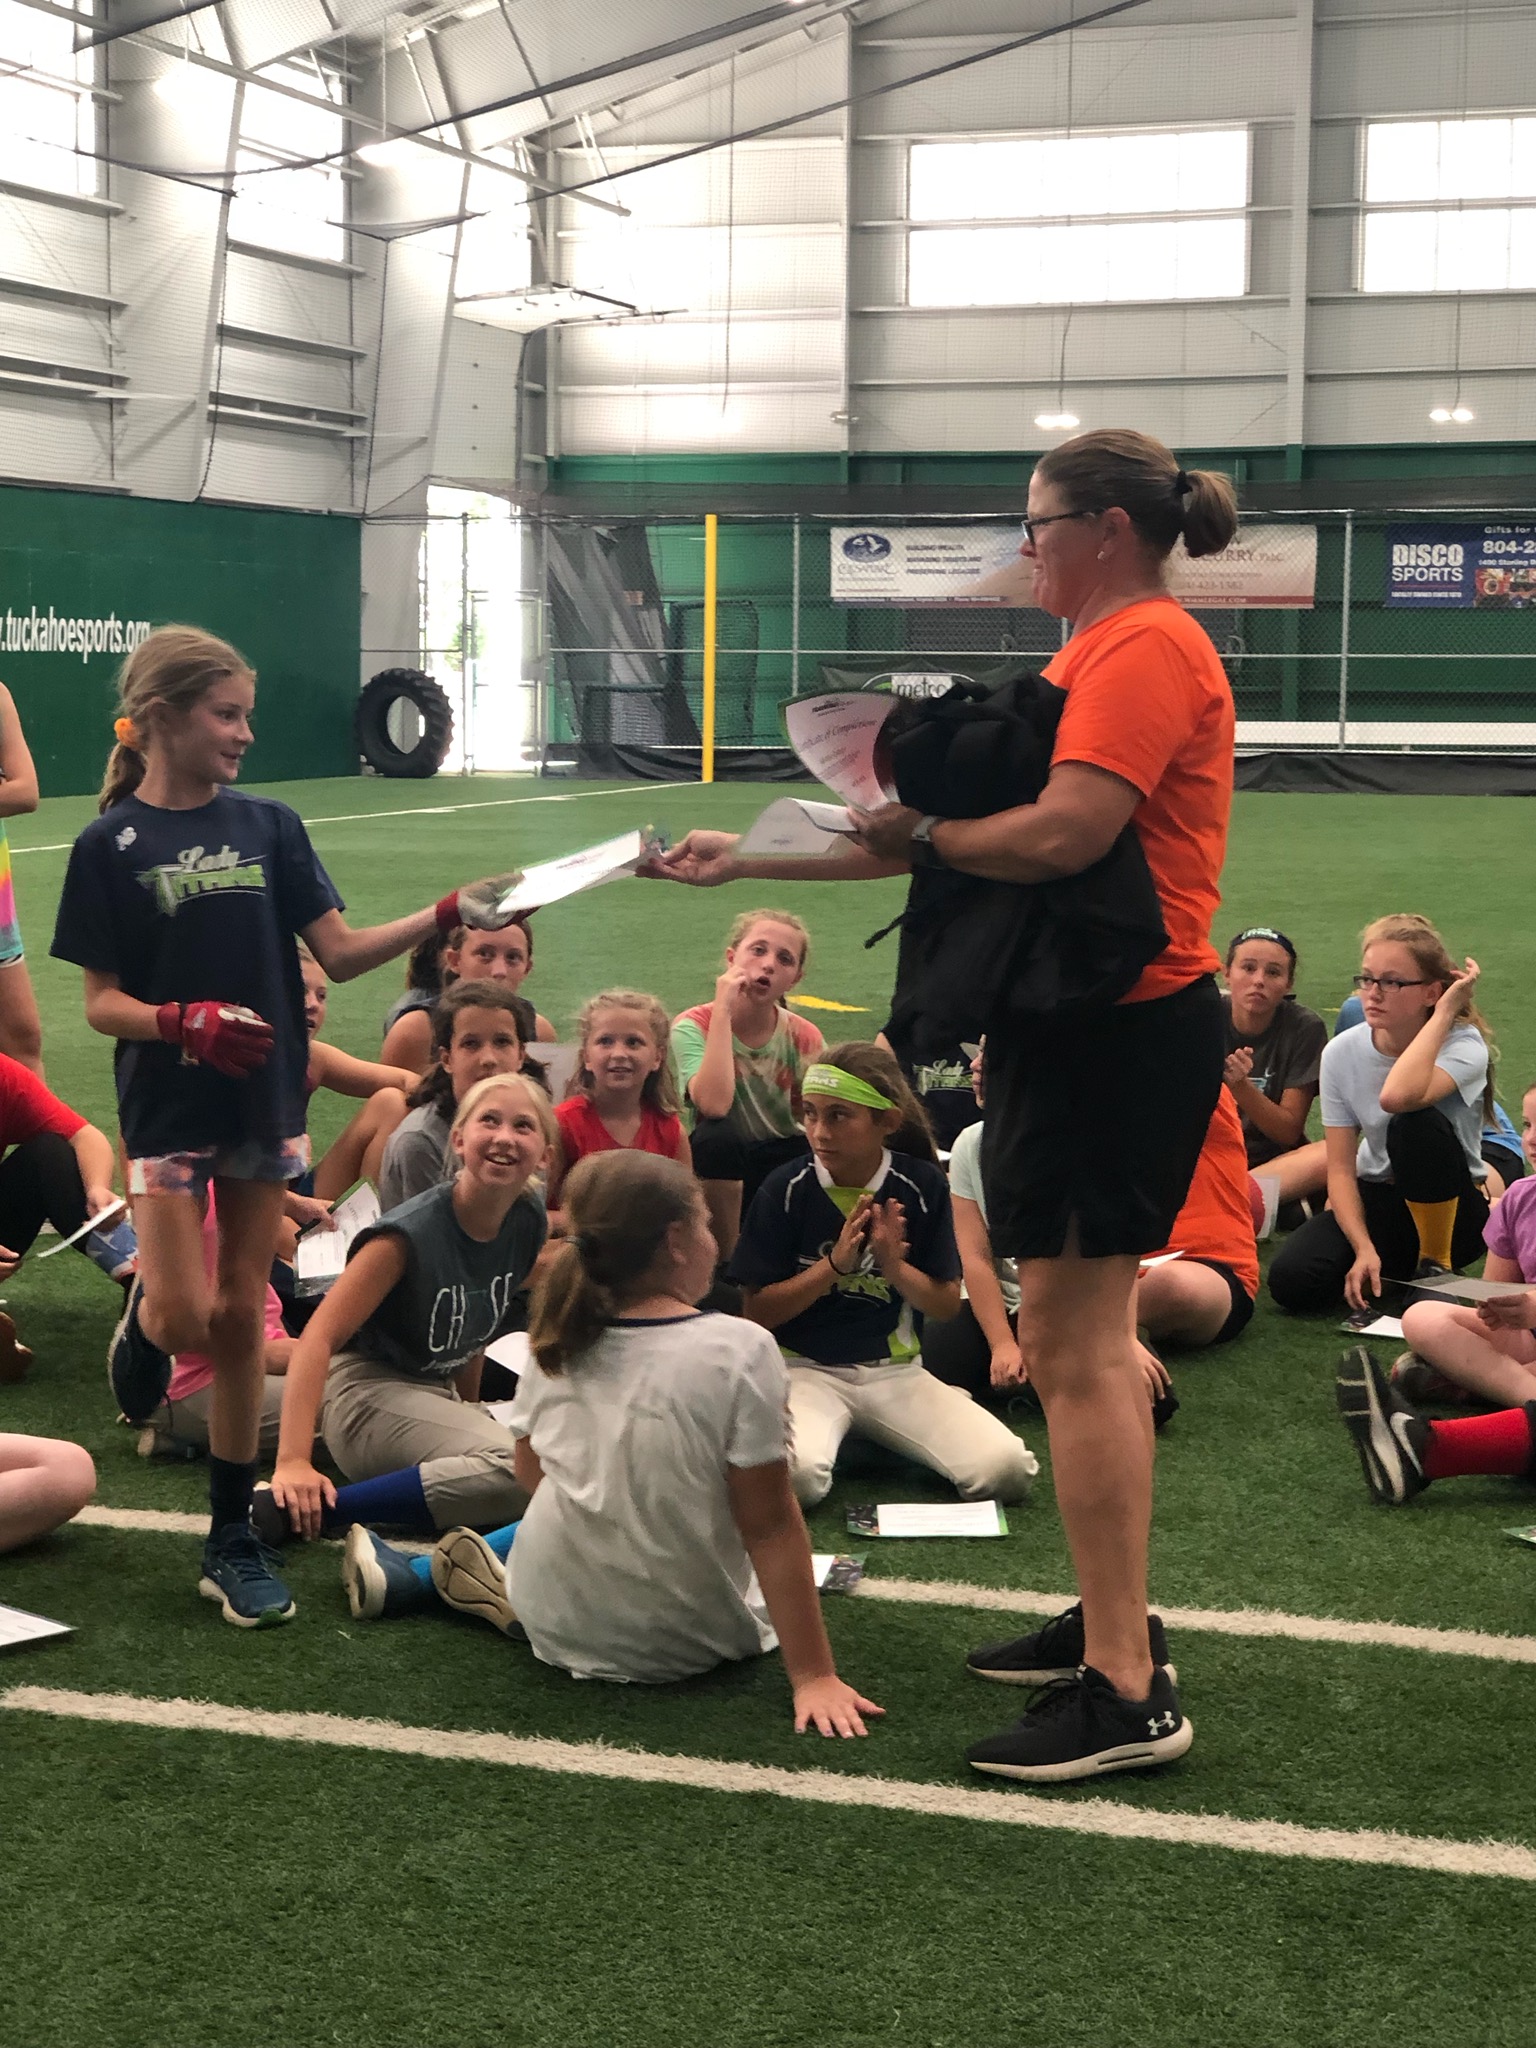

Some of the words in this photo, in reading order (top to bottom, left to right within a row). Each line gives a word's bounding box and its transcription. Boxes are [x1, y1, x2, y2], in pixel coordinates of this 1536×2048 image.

[1482, 540, 1536, 554] 804-2
[1392, 543, 1464, 567] DISCO
[1392, 567, 1464, 582] SPORTS
